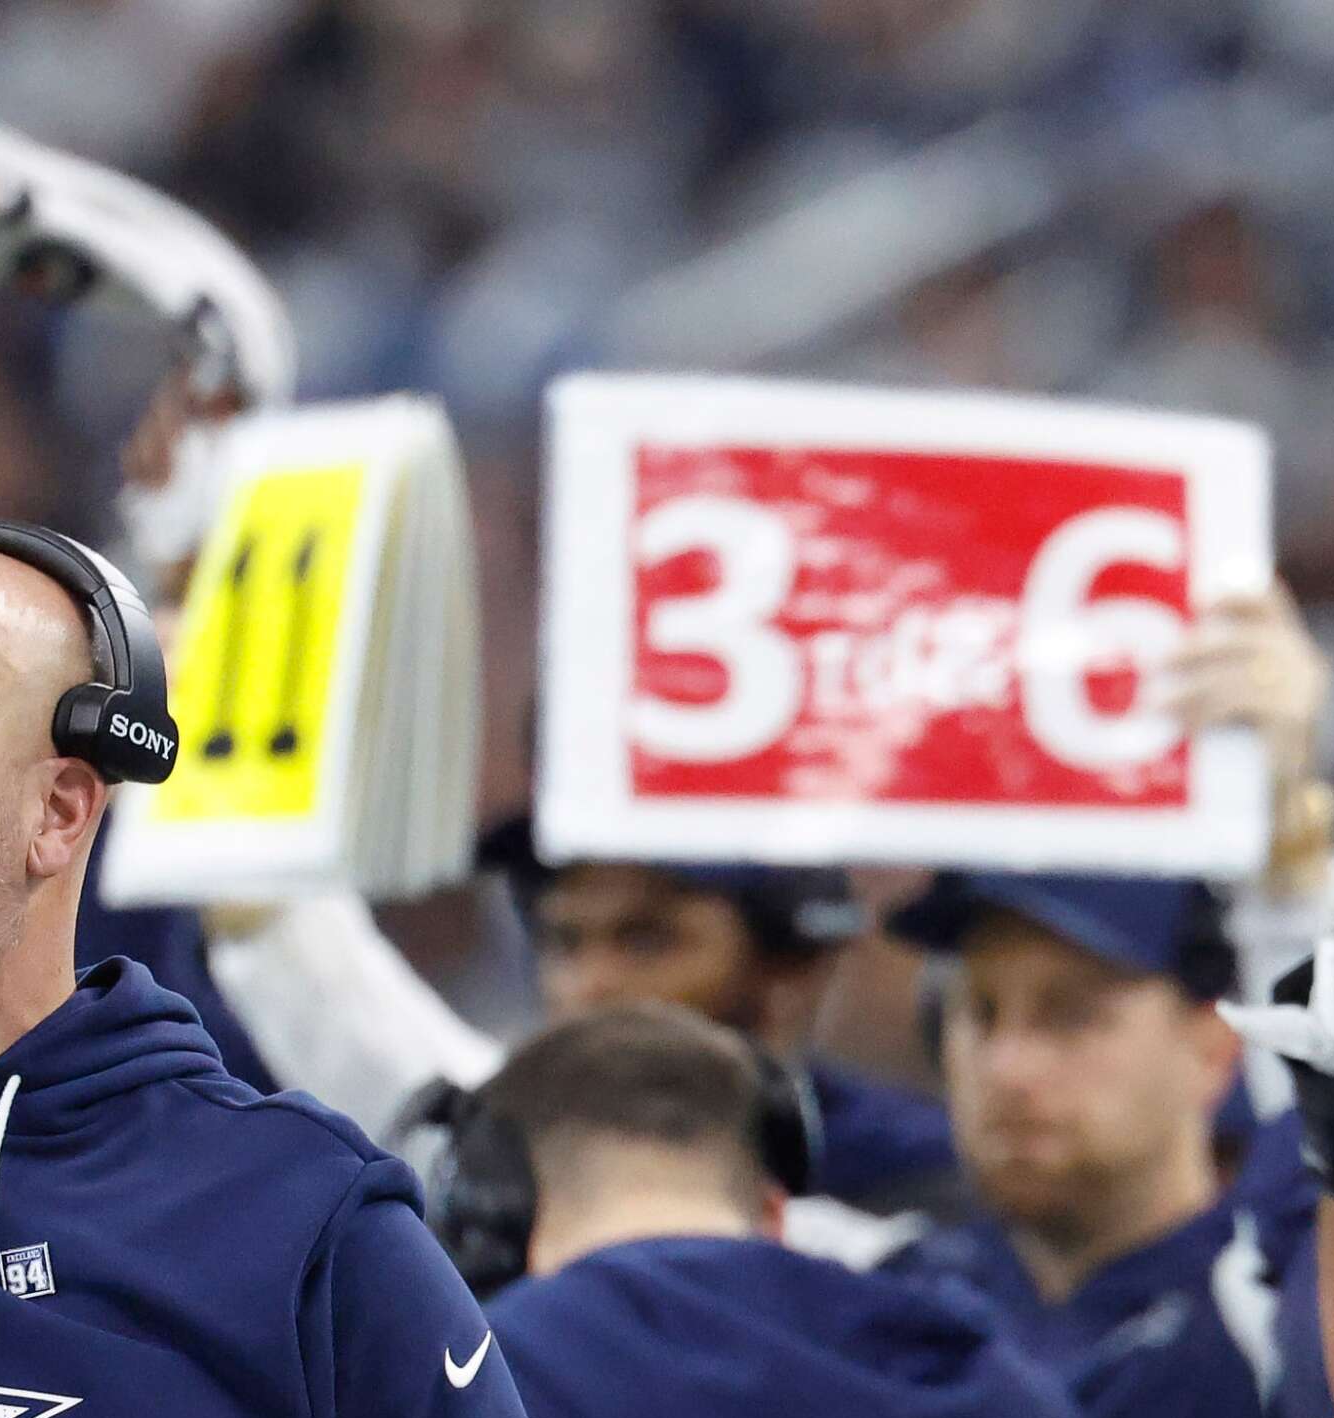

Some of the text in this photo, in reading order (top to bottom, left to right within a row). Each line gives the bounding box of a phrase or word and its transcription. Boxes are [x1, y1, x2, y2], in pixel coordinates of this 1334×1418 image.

[631, 494, 804, 762] 3
[1020, 504, 1190, 772] 6
[110, 713, 176, 761] SONY
[5, 1259, 48, 1294] 94
